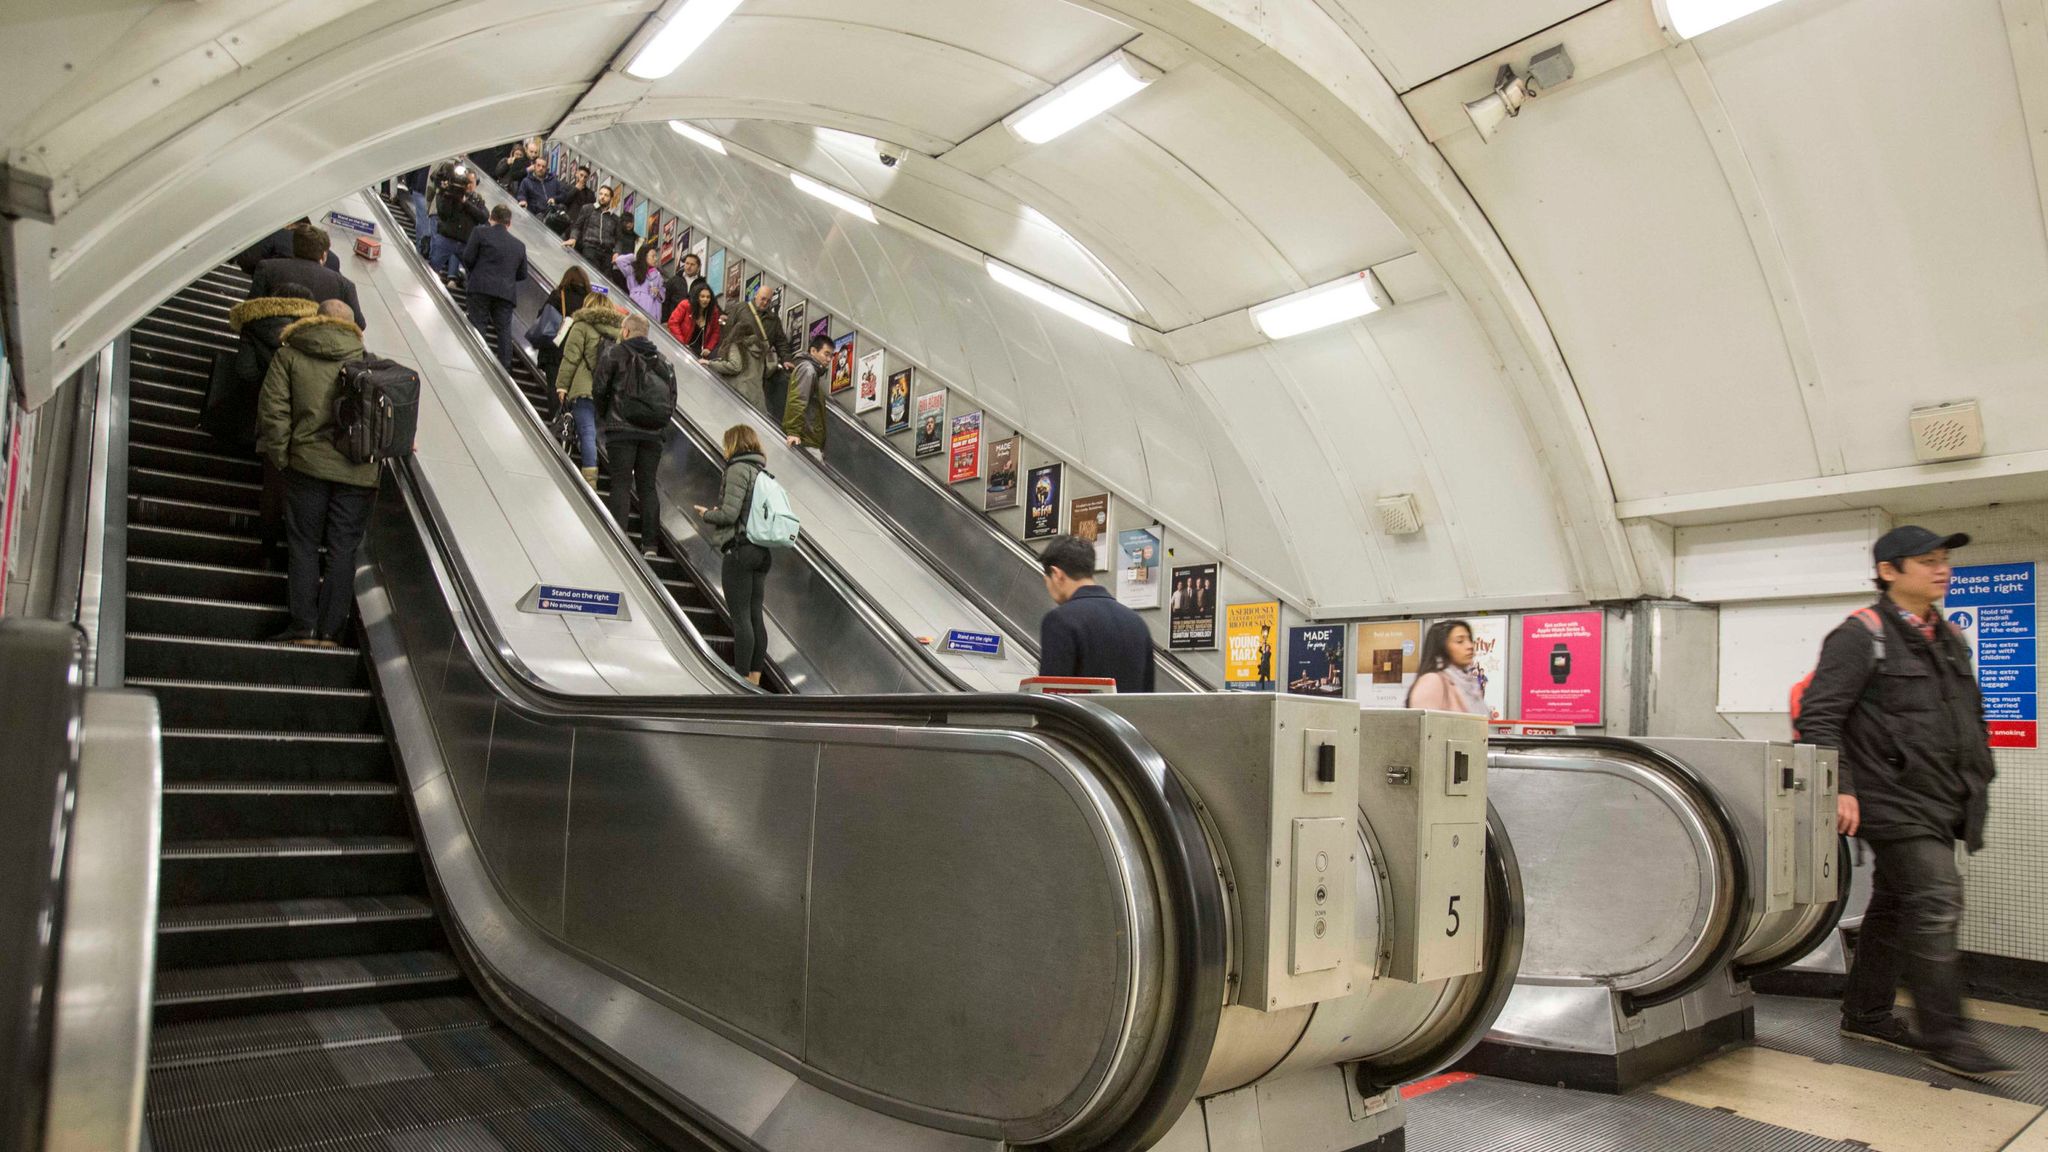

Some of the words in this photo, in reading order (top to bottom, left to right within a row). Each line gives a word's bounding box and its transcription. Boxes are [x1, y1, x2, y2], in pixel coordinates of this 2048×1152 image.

[996, 442, 1012, 452] MADE
[1950, 574, 1990, 585] Please
[1993, 571, 2029, 582] stand
[552, 589, 571, 597] Stand
[594, 593, 609, 601] right
[1950, 587, 1966, 595] on
[1969, 584, 1990, 594] the
[1994, 582, 2024, 594] right
[1229, 635, 1260, 649] YOUNG
[1304, 631, 1330, 641] MADE
[1232, 648, 1257, 661] MARX
[1823, 854, 1829, 878] 6
[1446, 895, 1461, 937] 5
